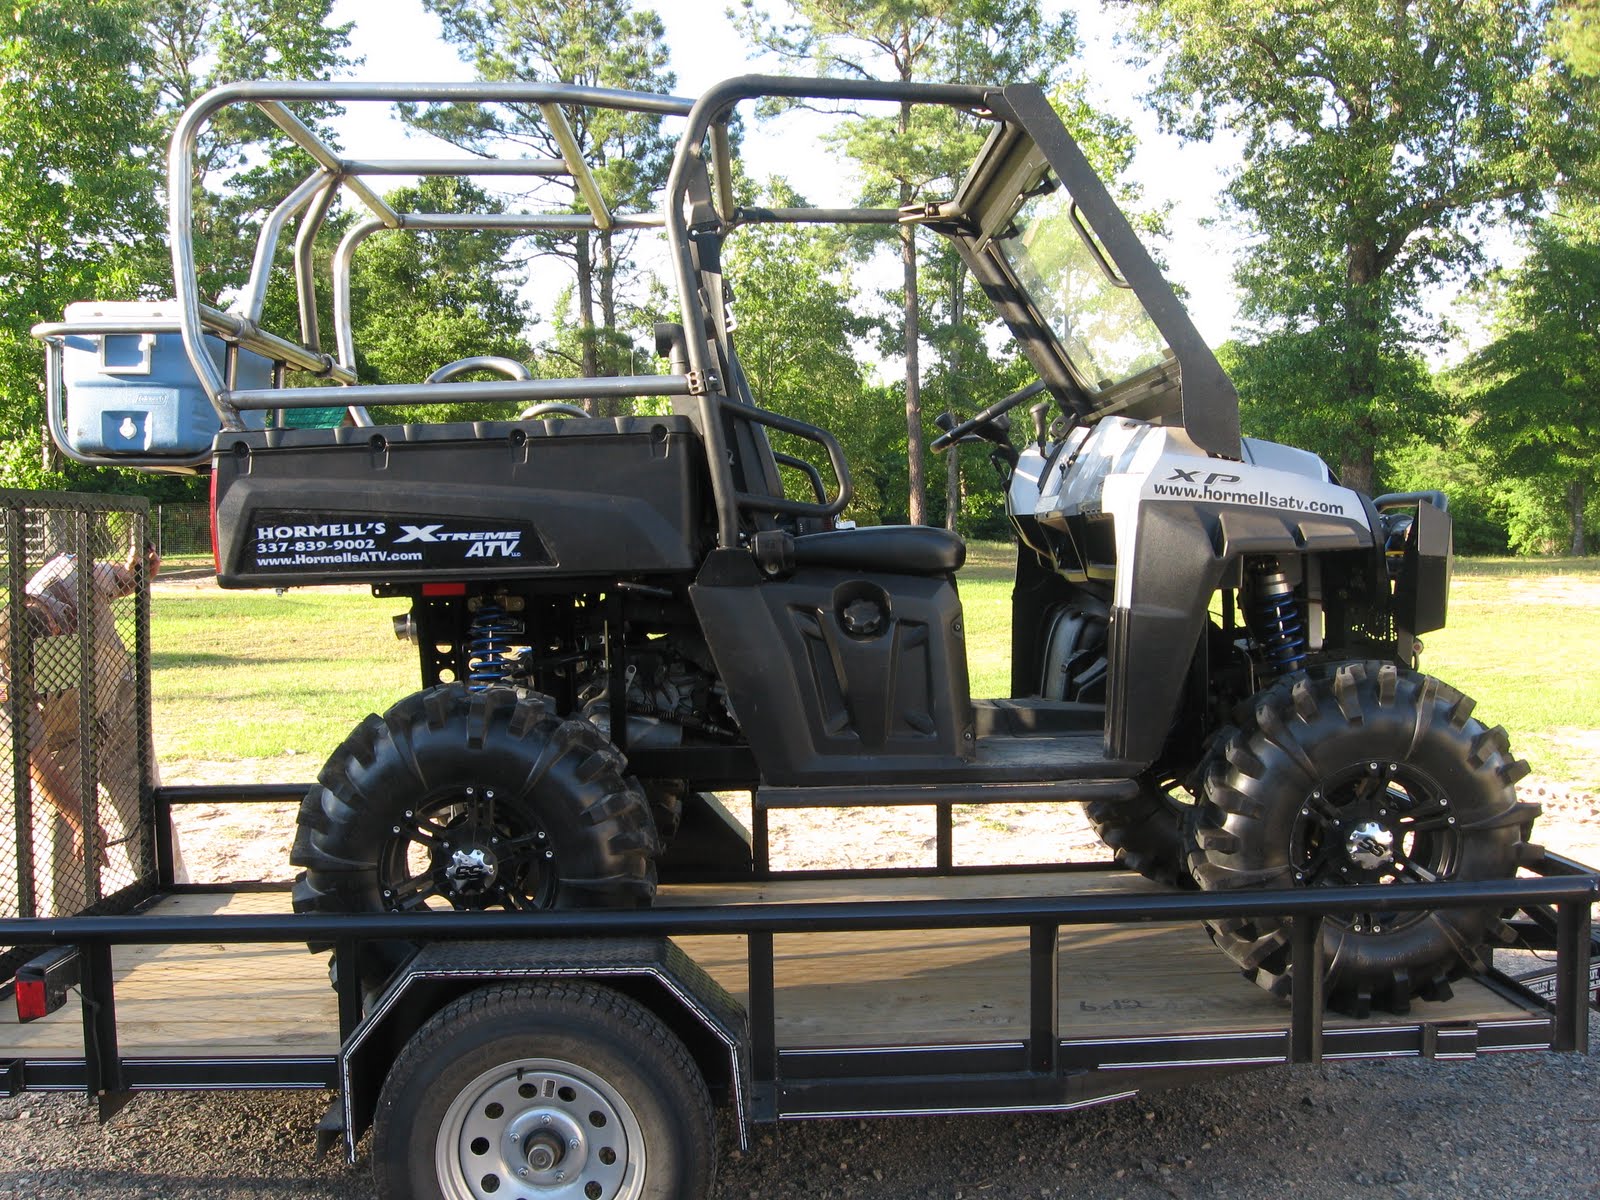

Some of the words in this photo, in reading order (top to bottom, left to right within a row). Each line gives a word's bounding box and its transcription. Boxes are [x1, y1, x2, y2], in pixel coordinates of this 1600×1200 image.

[1166, 468, 1241, 485] XP
[1154, 484, 1344, 515] www.hormellsatv.com
[257, 523, 386, 540] HORMELL'S
[257, 539, 376, 553] 337-839-9002
[464, 541, 519, 557] ATV
[257, 551, 423, 566] www.HormellsATV.com
